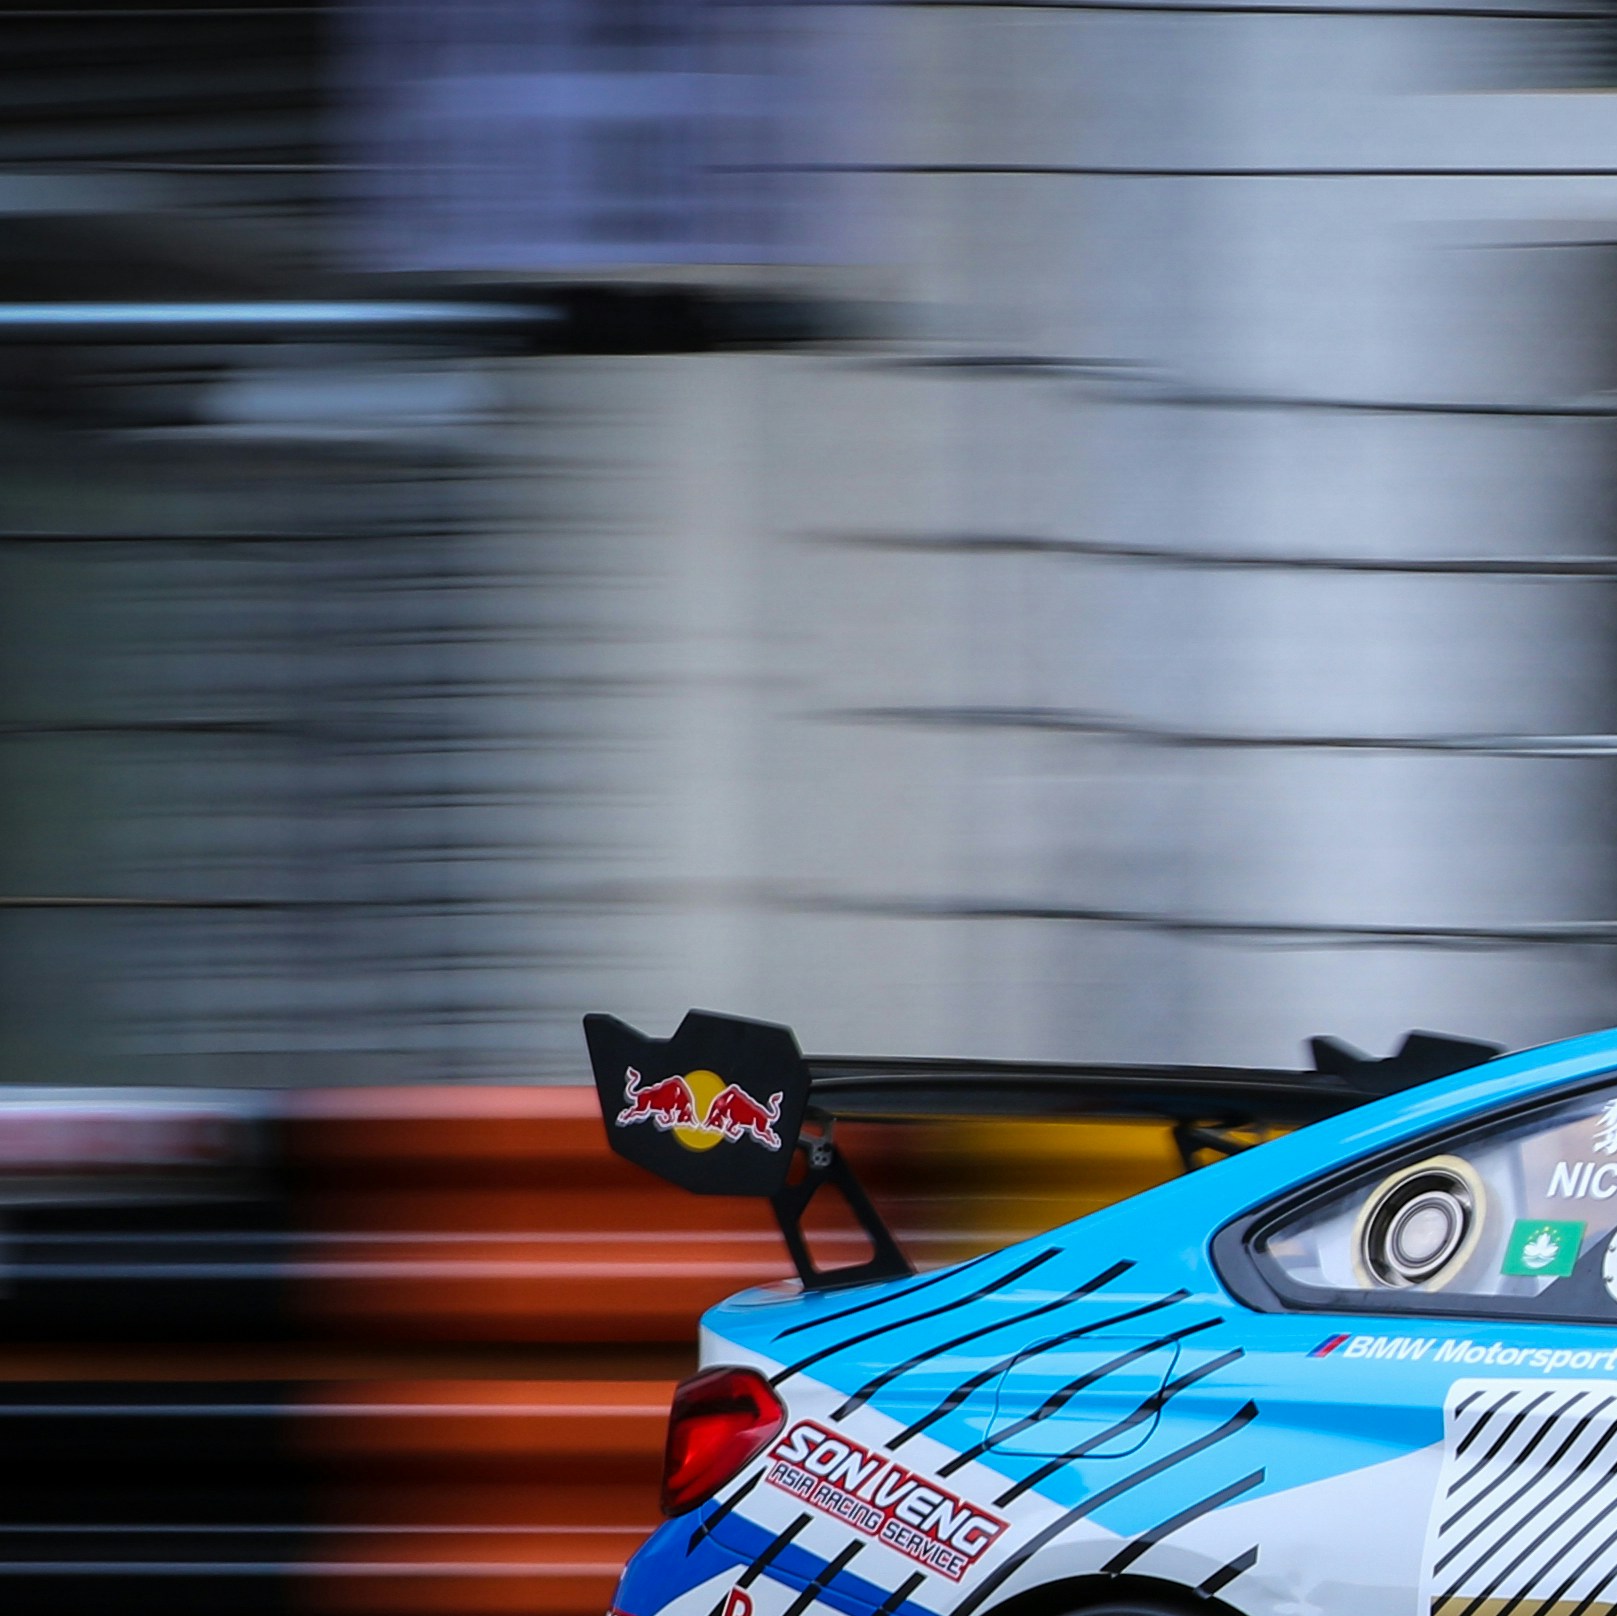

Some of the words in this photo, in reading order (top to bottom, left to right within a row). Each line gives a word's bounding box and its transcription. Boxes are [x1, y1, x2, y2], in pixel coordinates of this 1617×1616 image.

[1342, 1334, 1437, 1361] BMW
[771, 1462, 816, 1497] ASIA
[813, 1482, 883, 1532] RACING
[882, 1521, 967, 1576] SERVICE
[775, 1426, 879, 1490] SON
[874, 1470, 1001, 1557] VENG
